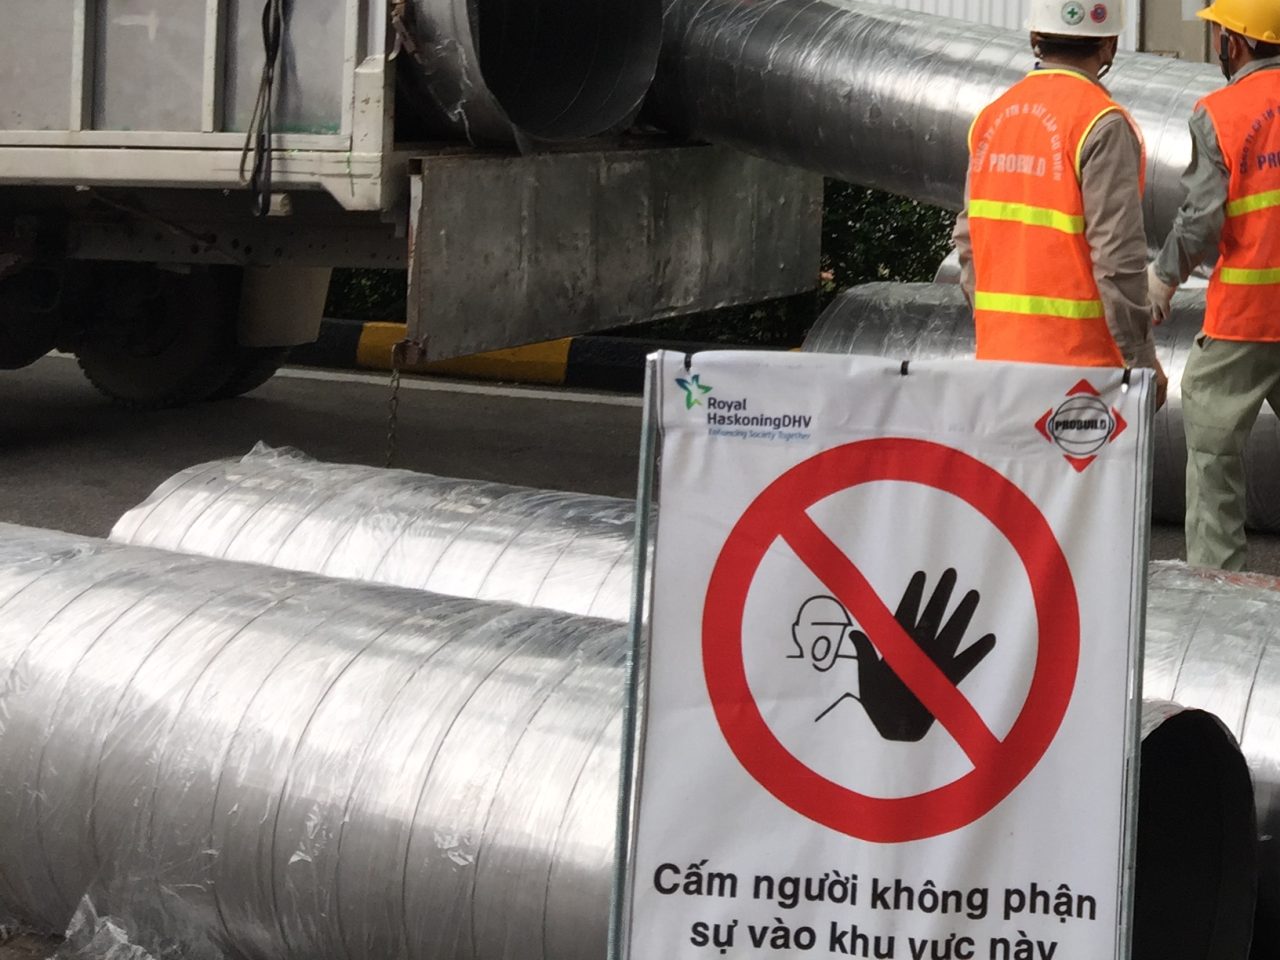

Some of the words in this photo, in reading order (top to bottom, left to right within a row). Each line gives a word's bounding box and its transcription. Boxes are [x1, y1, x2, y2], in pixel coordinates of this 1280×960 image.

[707, 397, 747, 413] Royal
[707, 413, 812, 429] HaskoningDHV
[1055, 419, 1107, 431] PROBUILD
[653, 860, 737, 898] Cấm
[753, 870, 858, 909] người
[871, 878, 989, 920] không
[1003, 883, 1097, 923] phận
[690, 919, 738, 954] sự
[748, 917, 816, 951] vào
[829, 921, 895, 959] khu
